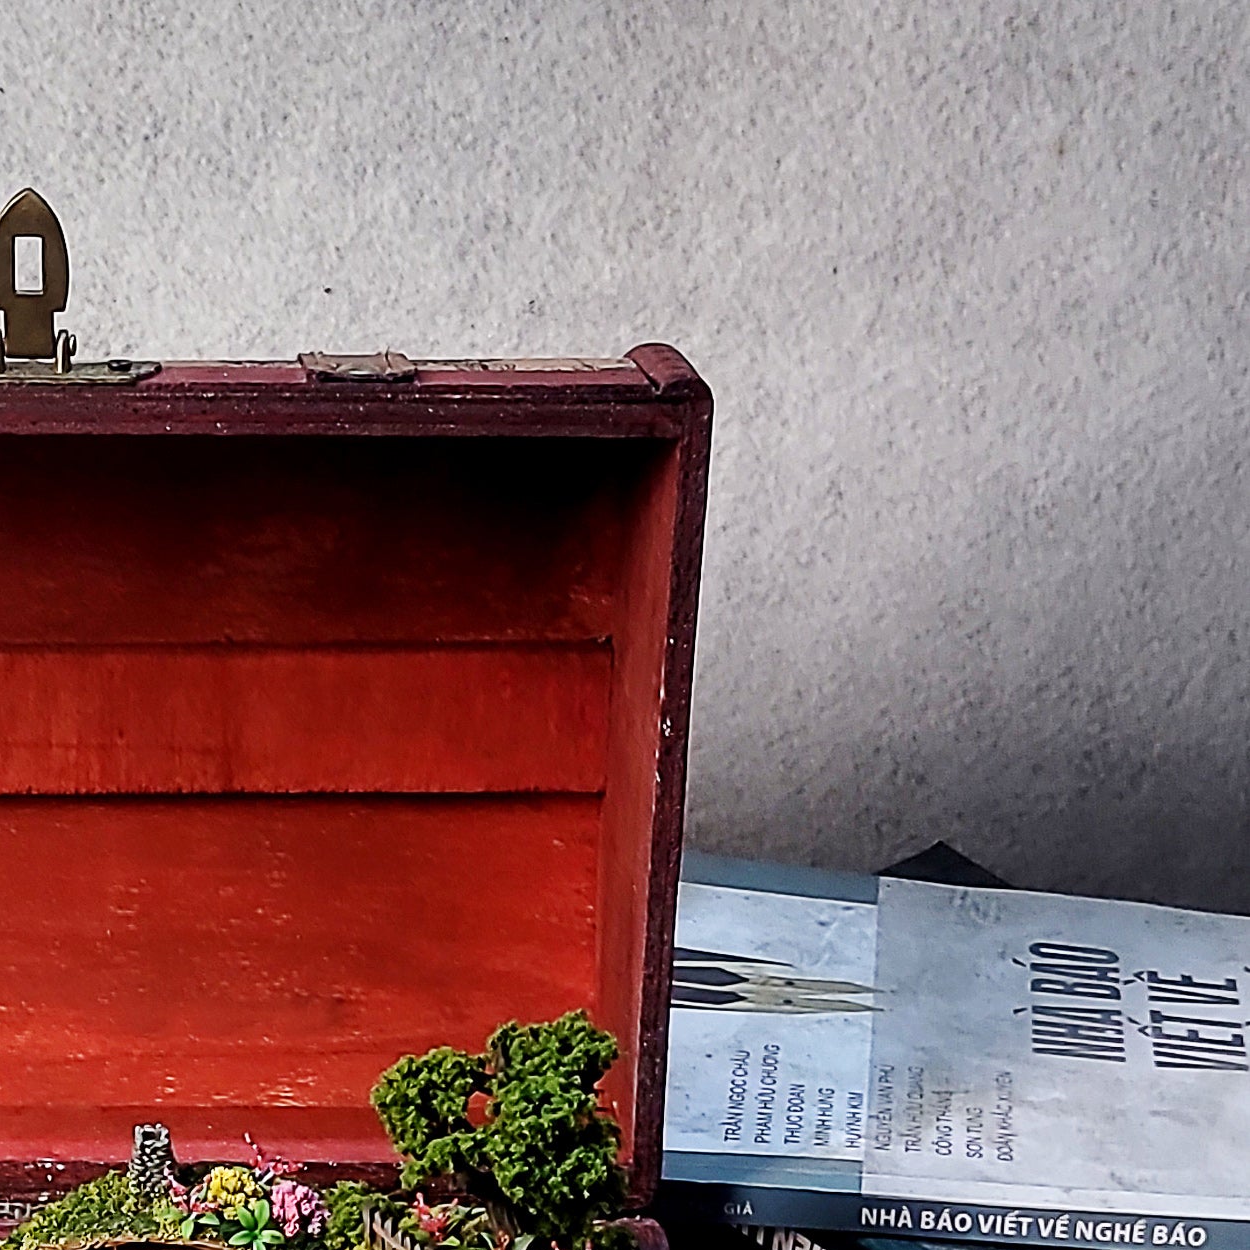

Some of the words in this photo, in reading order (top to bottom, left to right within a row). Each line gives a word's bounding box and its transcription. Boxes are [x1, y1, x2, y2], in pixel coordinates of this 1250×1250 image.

[1012, 941, 1121, 1001] BÁO
[1123, 969, 1240, 1006] VỀ
[1012, 1004, 1126, 1063] NHÀ
[1126, 1009, 1250, 1072] VIẾT
[860, 1205, 913, 1230] NHÀ
[920, 1205, 971, 1233] BÁO
[977, 1206, 1035, 1237] VIẾT
[1039, 1209, 1069, 1239] VỀ
[1074, 1211, 1147, 1244] NGHỀ
[1152, 1216, 1207, 1248] BÁO
